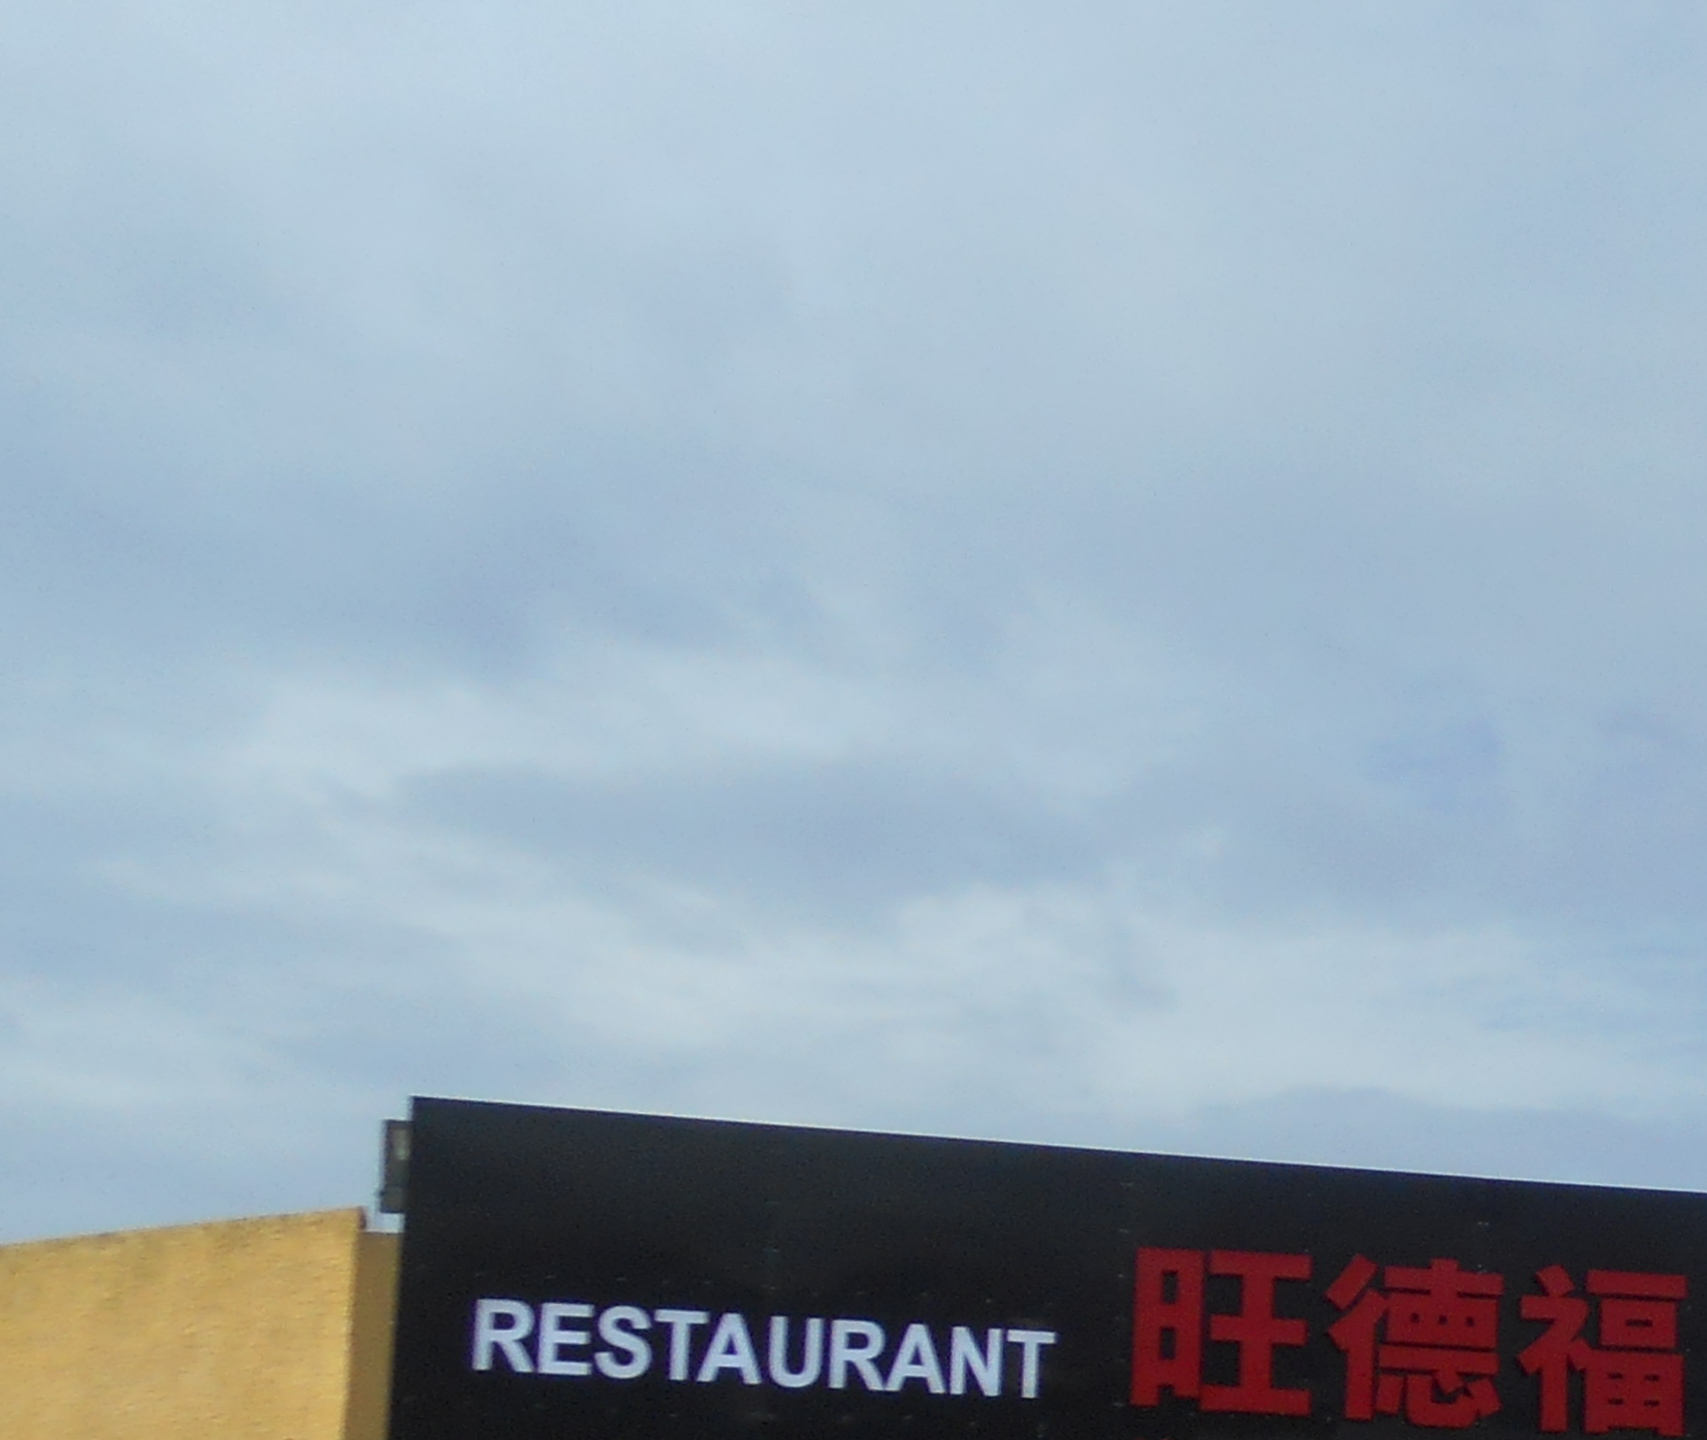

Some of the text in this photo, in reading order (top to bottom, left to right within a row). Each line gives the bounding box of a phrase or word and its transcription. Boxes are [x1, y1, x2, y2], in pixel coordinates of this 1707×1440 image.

[470, 1296, 1057, 1400] RESTAURANT
[1130, 1246, 1687, 1438] 旺德福
